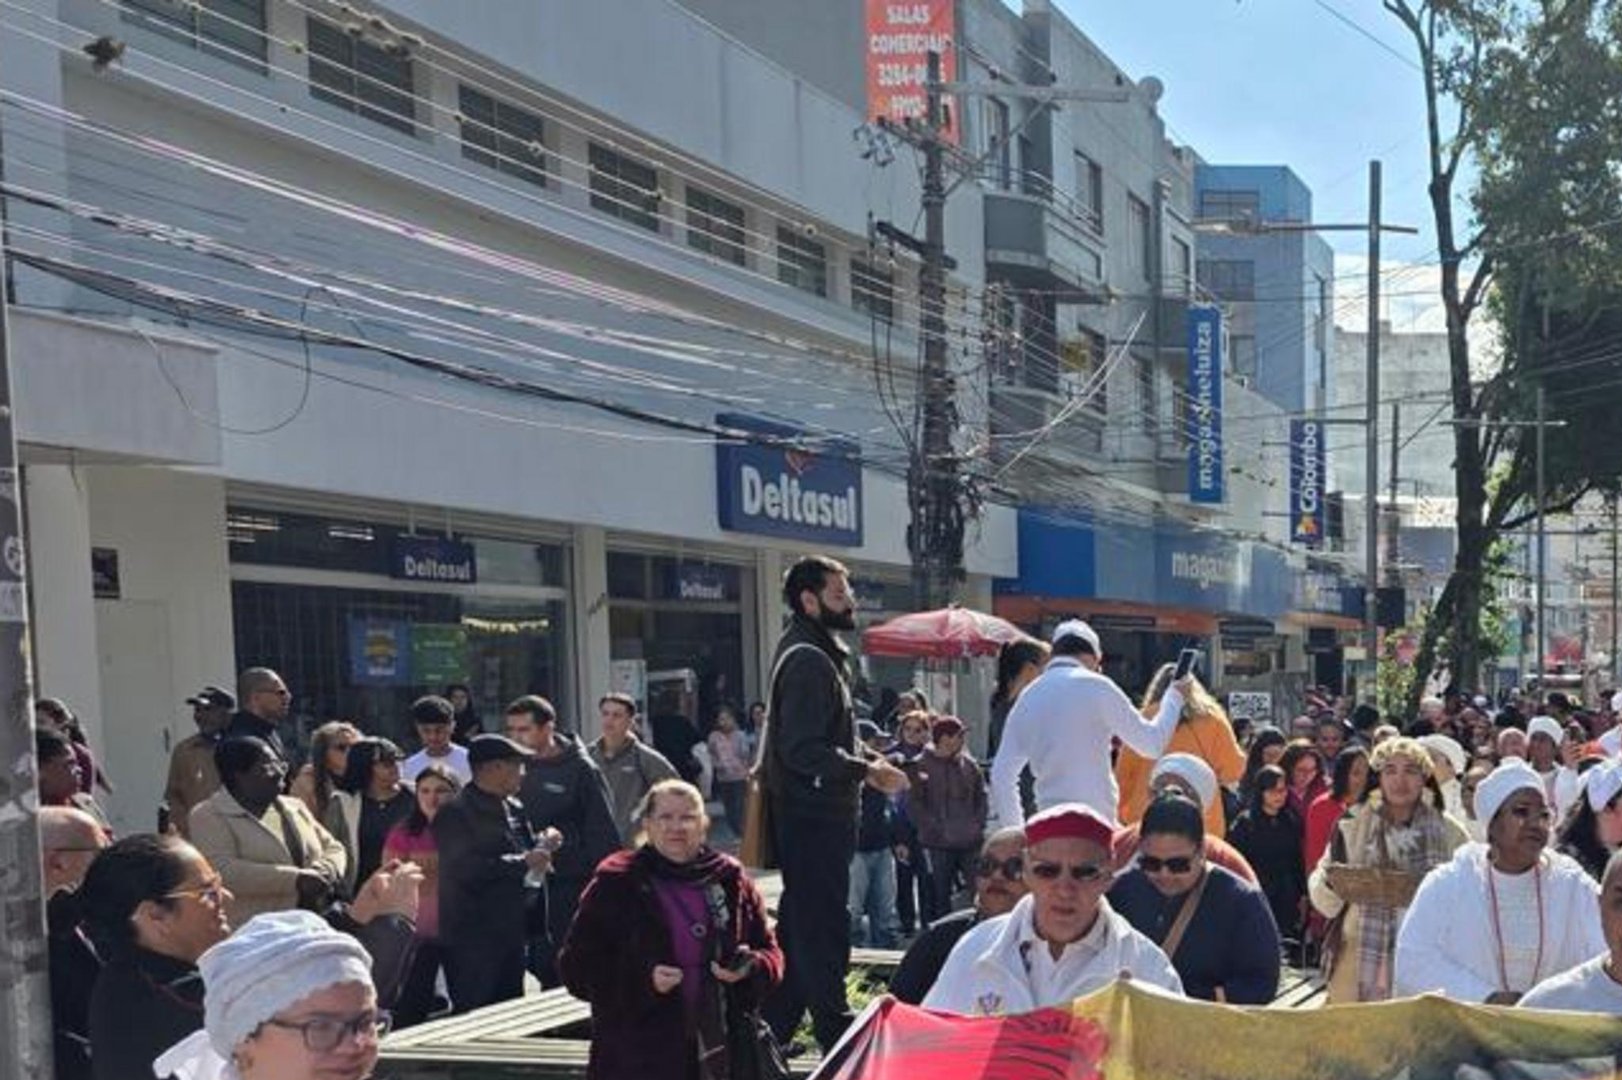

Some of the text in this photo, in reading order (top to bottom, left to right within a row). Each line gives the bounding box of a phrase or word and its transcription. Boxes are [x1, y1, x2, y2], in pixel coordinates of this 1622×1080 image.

[886, 4, 929, 24] SALAS
[1301, 422, 1318, 513] Colombo
[741, 464, 857, 532] Deltasul
[404, 555, 470, 580] Deltasul
